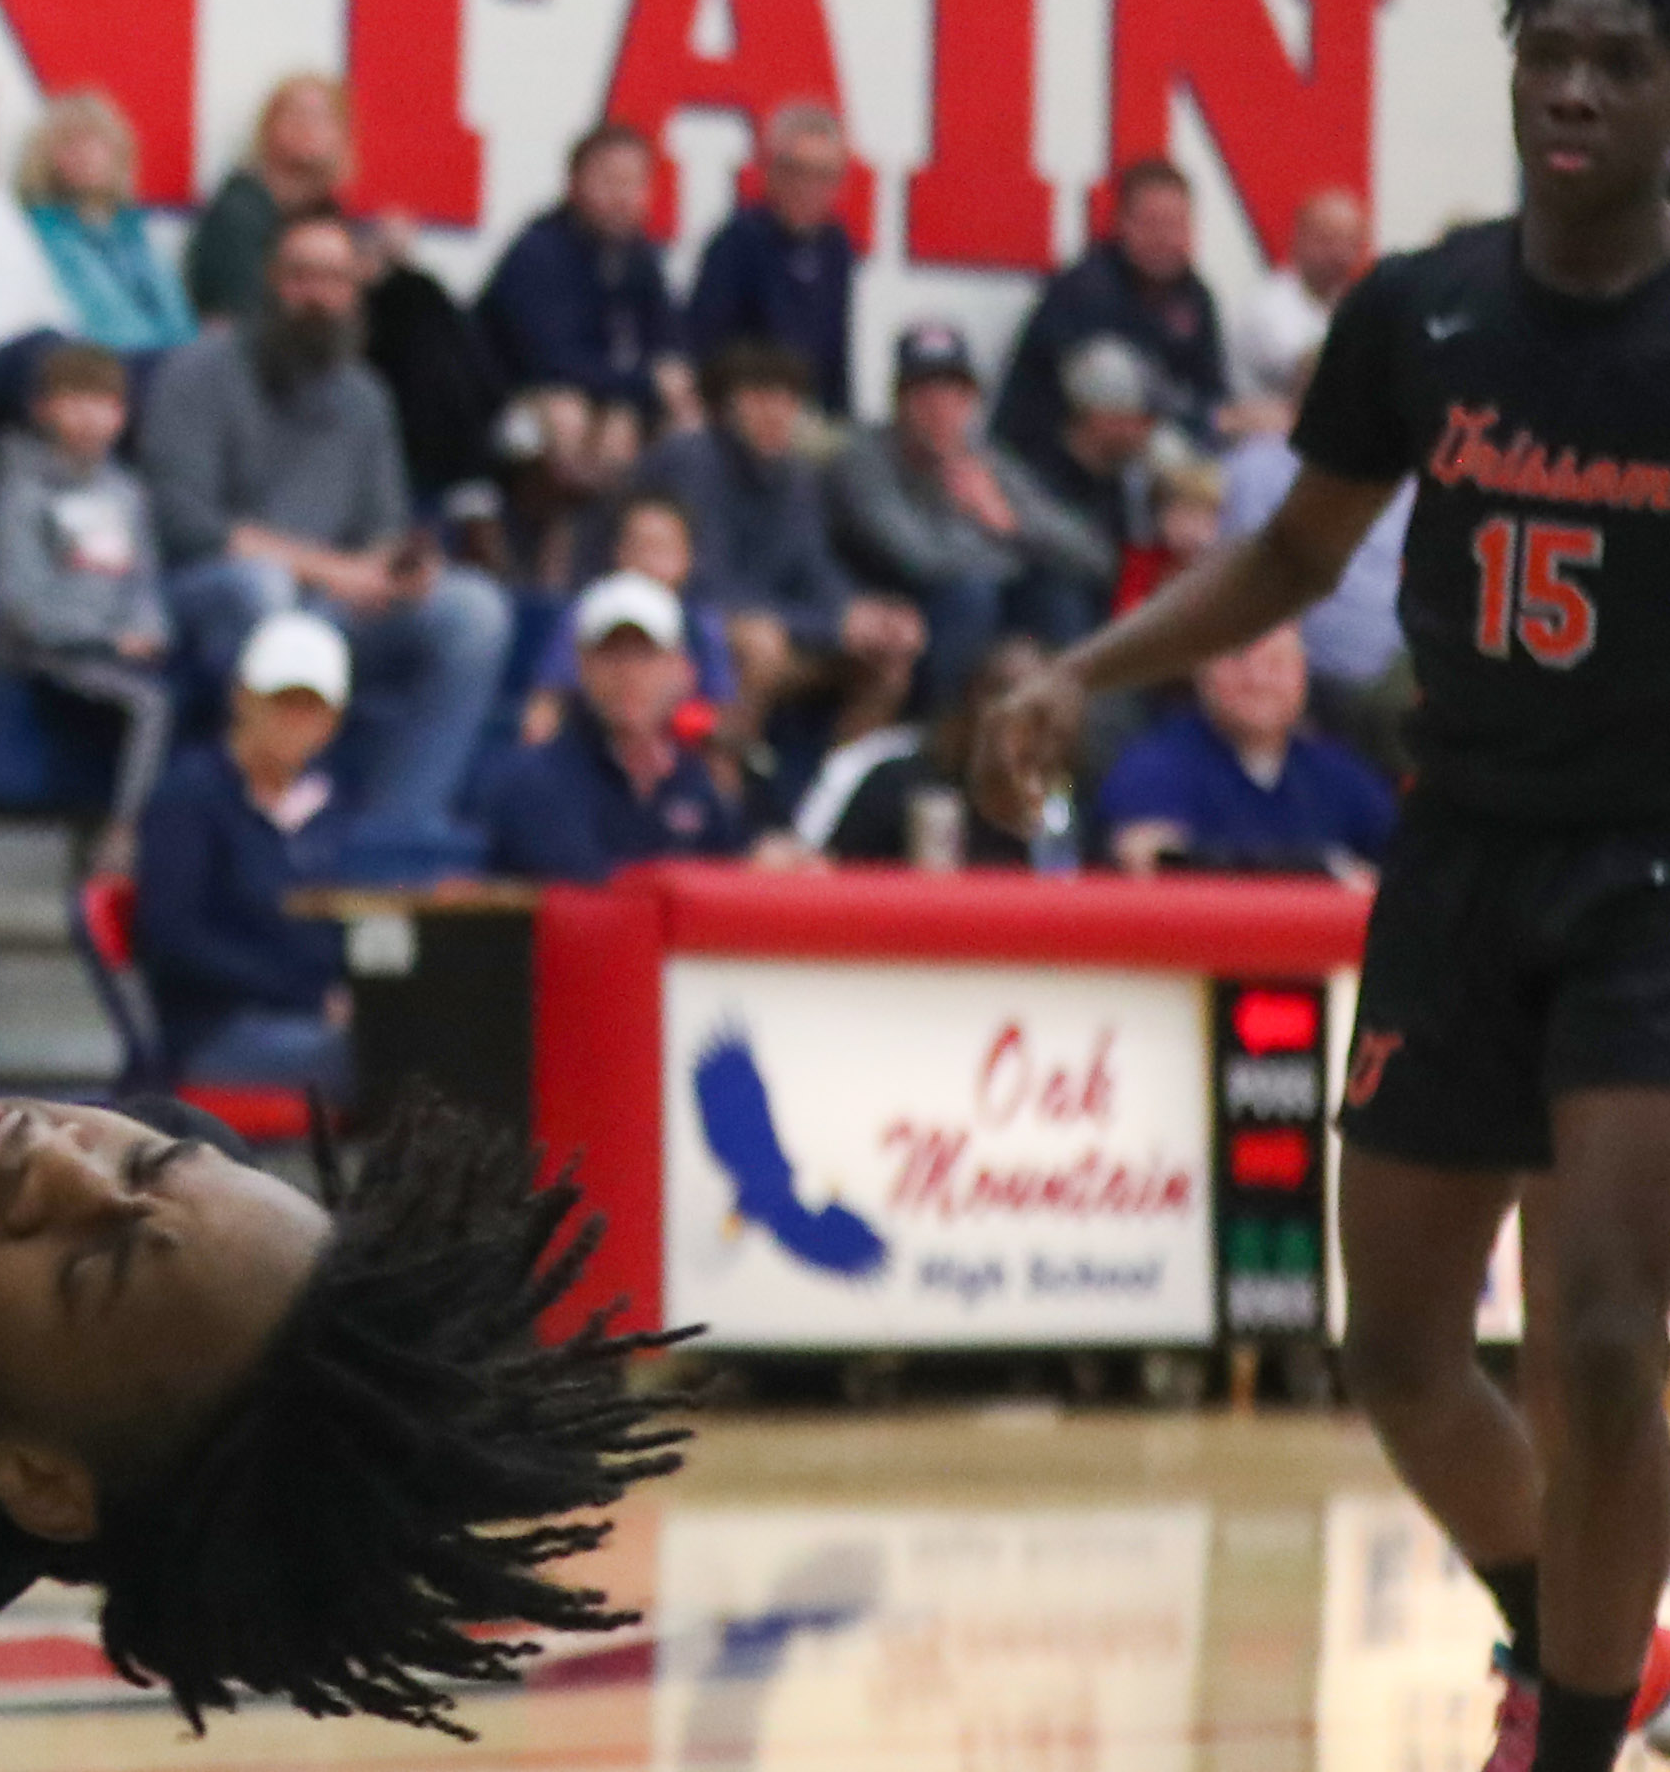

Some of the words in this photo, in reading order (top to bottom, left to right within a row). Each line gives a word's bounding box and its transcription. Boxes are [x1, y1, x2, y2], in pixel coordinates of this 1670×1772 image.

[1474, 517, 1604, 670] 15
[974, 1012, 1118, 1131] Oak
[877, 1114, 1194, 1221] Mountain
[912, 1251, 1008, 1314] High
[1027, 1250, 1168, 1296] School
